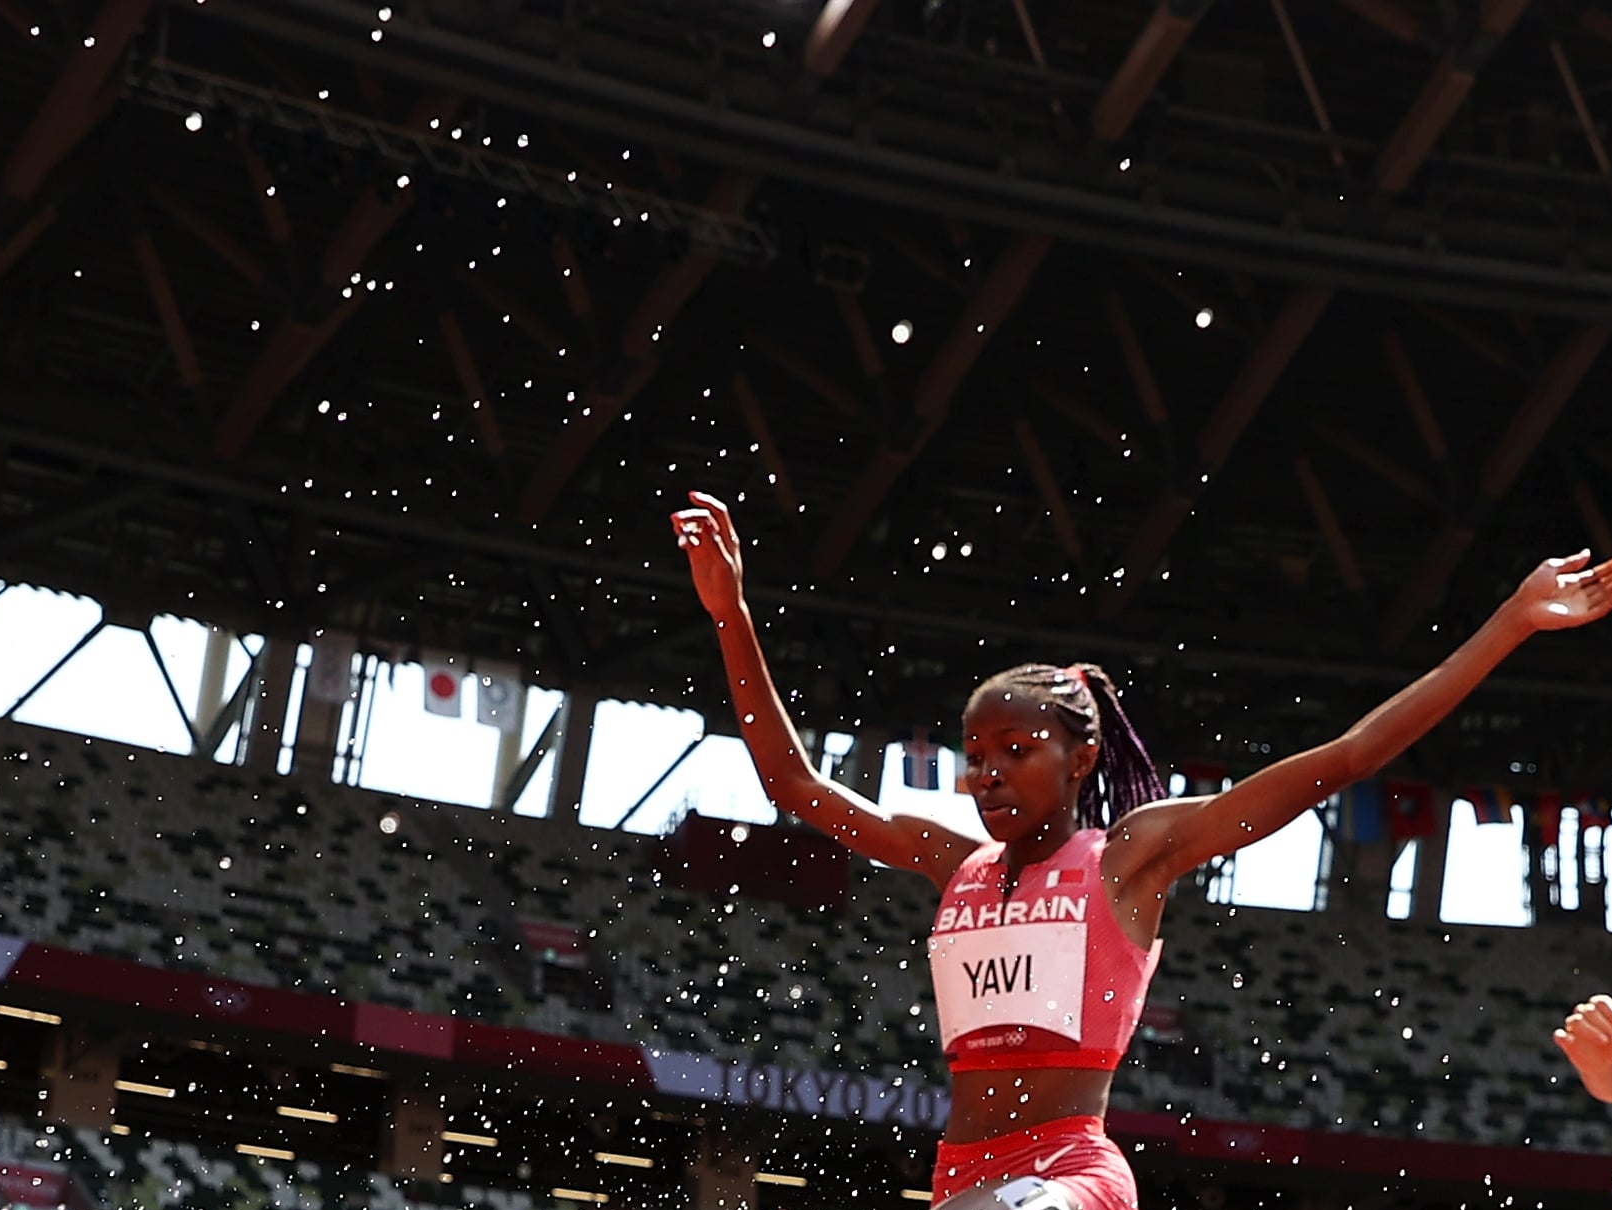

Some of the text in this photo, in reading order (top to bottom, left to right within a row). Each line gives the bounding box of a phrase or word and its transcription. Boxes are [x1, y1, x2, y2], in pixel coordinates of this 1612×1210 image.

[938, 896, 1088, 932] BAHRAIN
[962, 954, 1032, 999] YAVI
[714, 1059, 868, 1122] TOKYO
